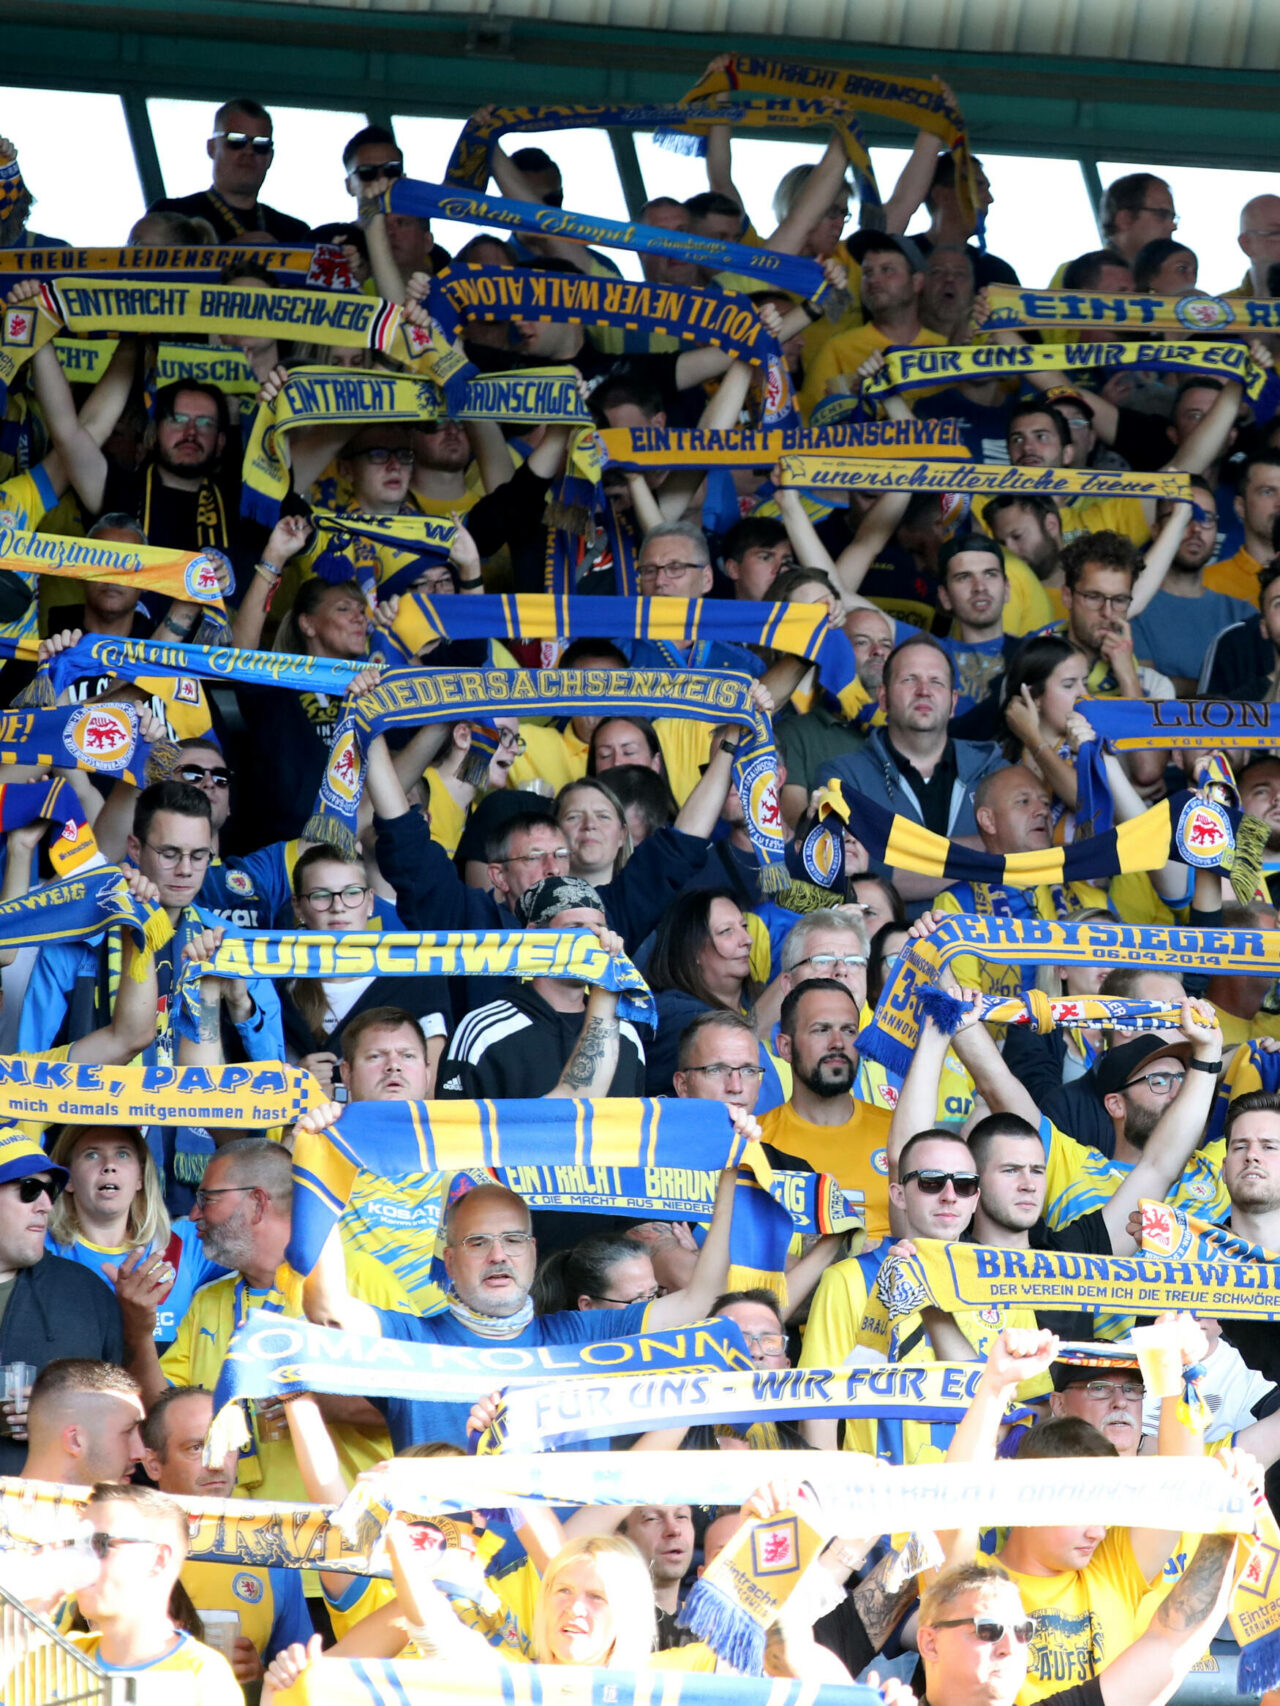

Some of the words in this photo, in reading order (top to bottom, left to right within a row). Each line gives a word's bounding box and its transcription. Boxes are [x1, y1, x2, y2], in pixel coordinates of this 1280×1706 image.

[14, 250, 90, 270] TREUE
[118, 249, 293, 269] LEIDENSCHAFT
[439, 274, 525, 313] ALONE!
[529, 276, 600, 313] WALK
[603, 281, 683, 320] NEVER
[1018, 293, 1164, 324] EINT
[61, 288, 191, 317] EINTRACHT
[200, 290, 375, 333] BRAUNSCHWEIG
[970, 344, 1033, 368] UNS
[1064, 343, 1125, 366] WIR
[283, 378, 397, 414] EINTRACHT
[631, 427, 774, 452] EINTRACHT
[811, 460, 1069, 493] unerschütterliche
[1076, 469, 1157, 493] Treue
[92, 638, 189, 669] Mein
[1145, 700, 1270, 729] LION
[1170, 737, 1240, 747] YOU'LL
[924, 913, 1259, 956] DERBYSIEGER
[1092, 947, 1221, 967] 06.04.2014
[142, 1064, 289, 1096] PAPA
[9, 1098, 49, 1113] mich
[57, 1100, 119, 1116] damals
[128, 1103, 244, 1121] mitgenommen
[252, 1105, 287, 1120] hast
[541, 1195, 563, 1205] DIE
[569, 1196, 620, 1208] MACHT
[626, 1198, 656, 1210] AUS
[989, 1283, 1018, 1297] DER
[1021, 1284, 1075, 1299] VEREIN
[1077, 1286, 1108, 1300] DEM
[1110, 1287, 1135, 1301] ICH
[1138, 1288, 1161, 1302] DIE
[1164, 1289, 1210, 1303] TREUE
[626, 1374, 710, 1411] UNS
[751, 1371, 842, 1402] WIR
[846, 1367, 927, 1401] FÜR
